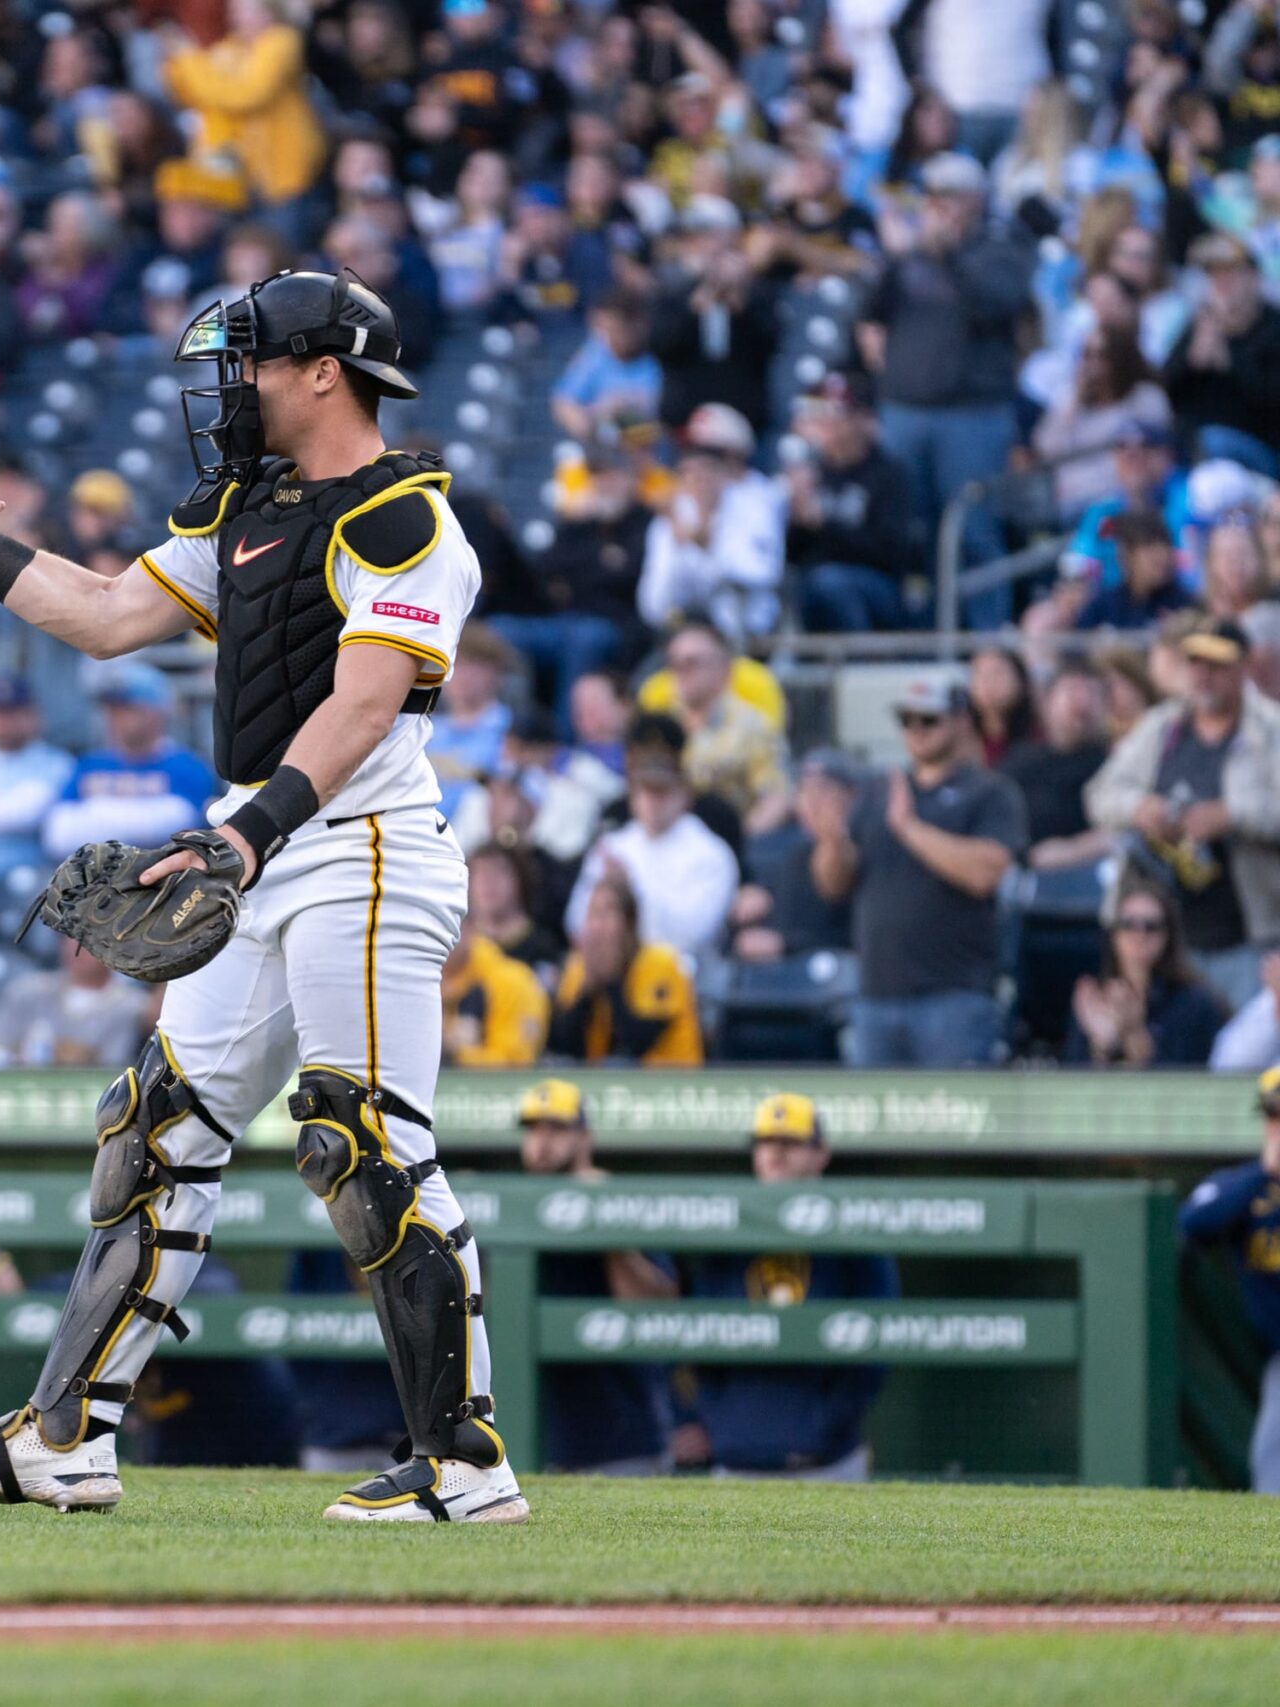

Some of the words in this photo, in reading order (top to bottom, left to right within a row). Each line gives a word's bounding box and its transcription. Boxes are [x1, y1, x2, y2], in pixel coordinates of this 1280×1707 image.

[275, 489, 302, 503] DAVIS
[376, 603, 436, 622] SHEETZ
[172, 888, 206, 928] ALL-STAR
